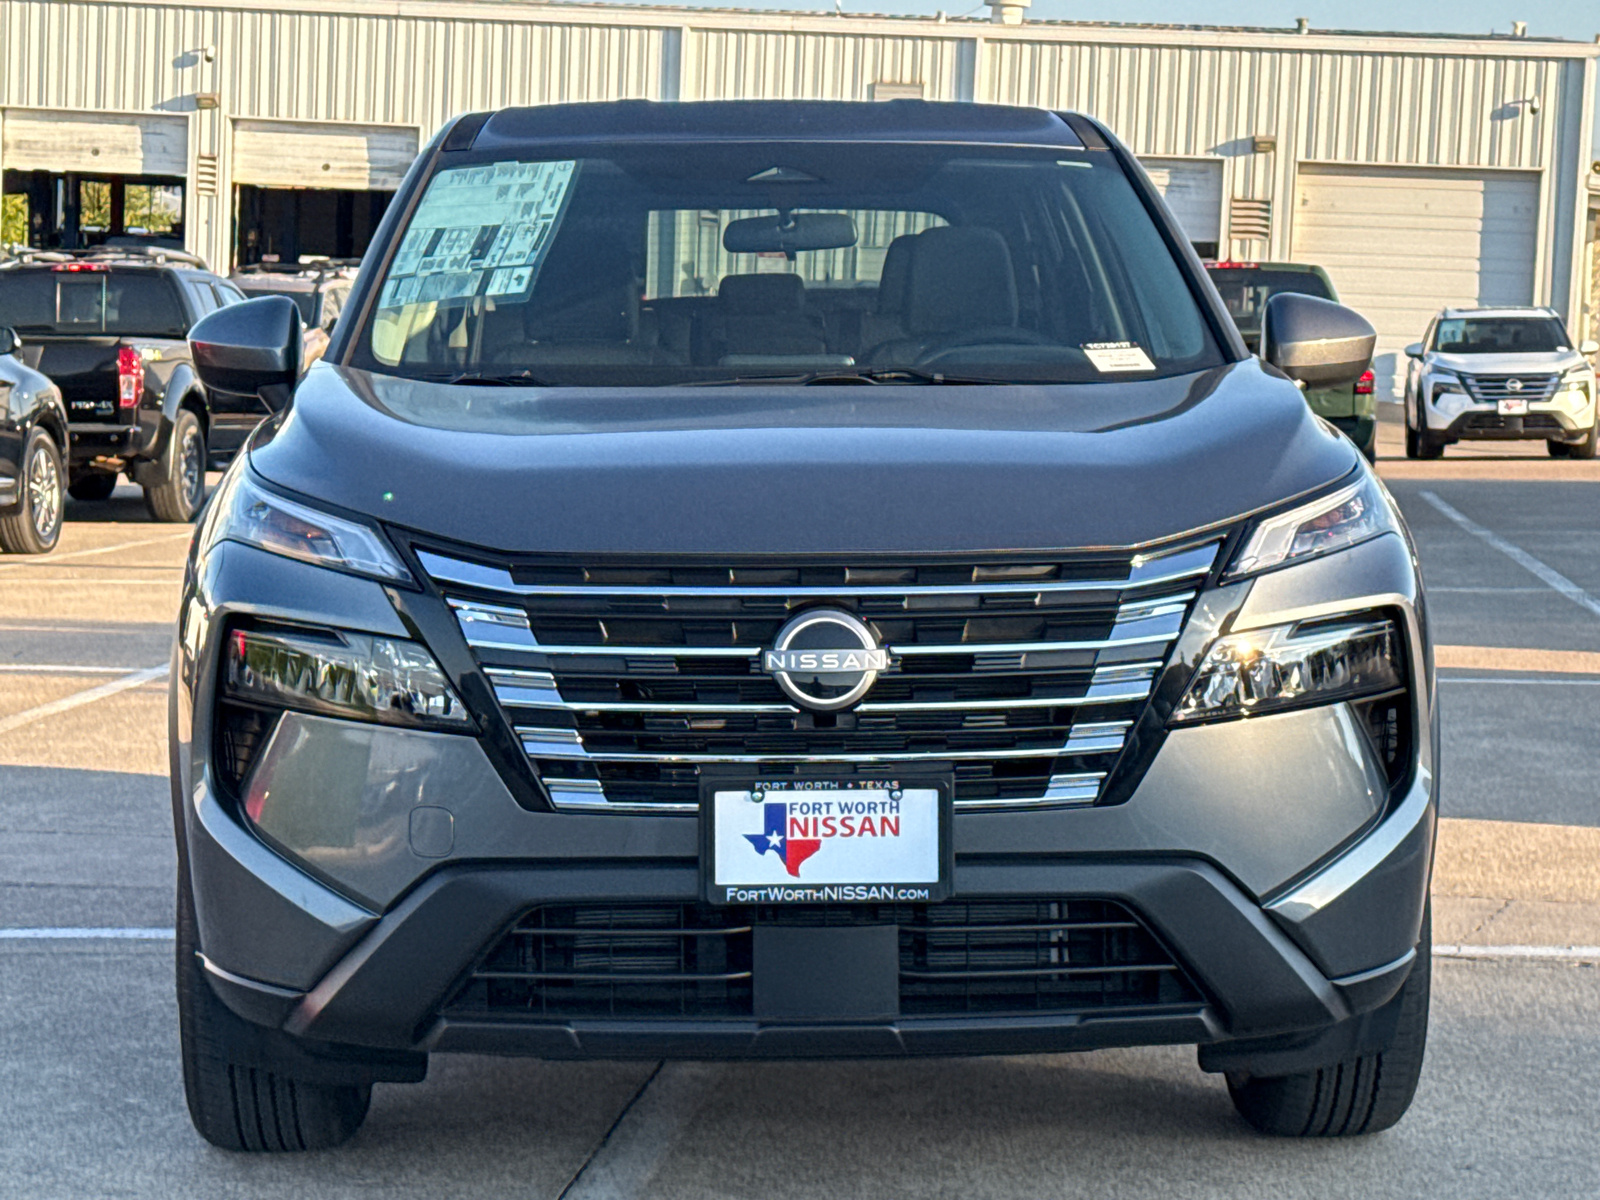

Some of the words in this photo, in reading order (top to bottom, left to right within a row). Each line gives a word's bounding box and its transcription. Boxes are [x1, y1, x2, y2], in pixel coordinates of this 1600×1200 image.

[768, 653, 883, 669] NISSAN
[755, 782, 787, 790] FORT
[794, 781, 839, 790] WORTH
[859, 780, 899, 789] TEXAS
[789, 802, 833, 815] FORT
[838, 801, 900, 815] WORTH
[789, 815, 900, 838] NISSAN
